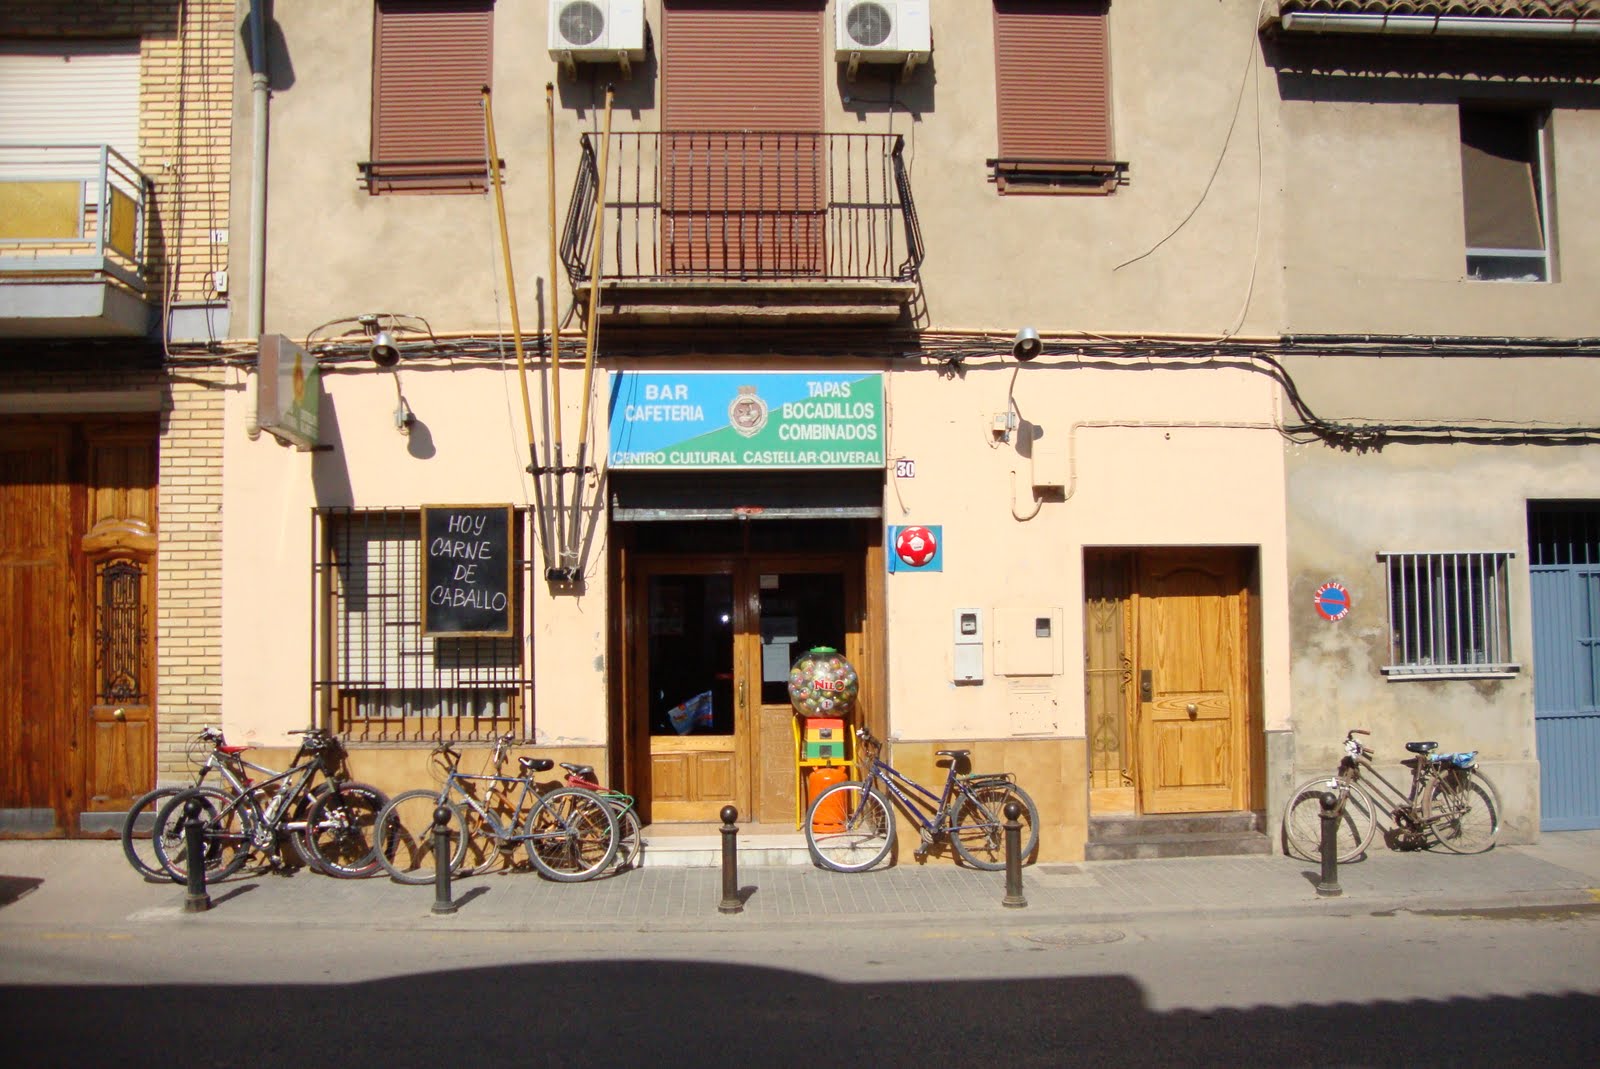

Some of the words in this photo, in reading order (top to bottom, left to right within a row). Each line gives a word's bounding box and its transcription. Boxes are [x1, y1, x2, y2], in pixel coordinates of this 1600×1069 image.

[645, 384, 689, 400] BAR
[807, 381, 851, 398] TAPAS
[625, 404, 705, 422] CAFETERIA
[782, 402, 875, 419] BOCADILLOS
[778, 423, 878, 441] COMBINADOS
[613, 451, 666, 465] CENTRO
[669, 451, 737, 464] CULTURAL
[896, 461, 915, 477] 30
[448, 515, 487, 536] HOY
[430, 537, 492, 560] CARNE
[453, 564, 478, 584] DE
[430, 585, 507, 611] CABALLO
[814, 679, 845, 692] NILO
